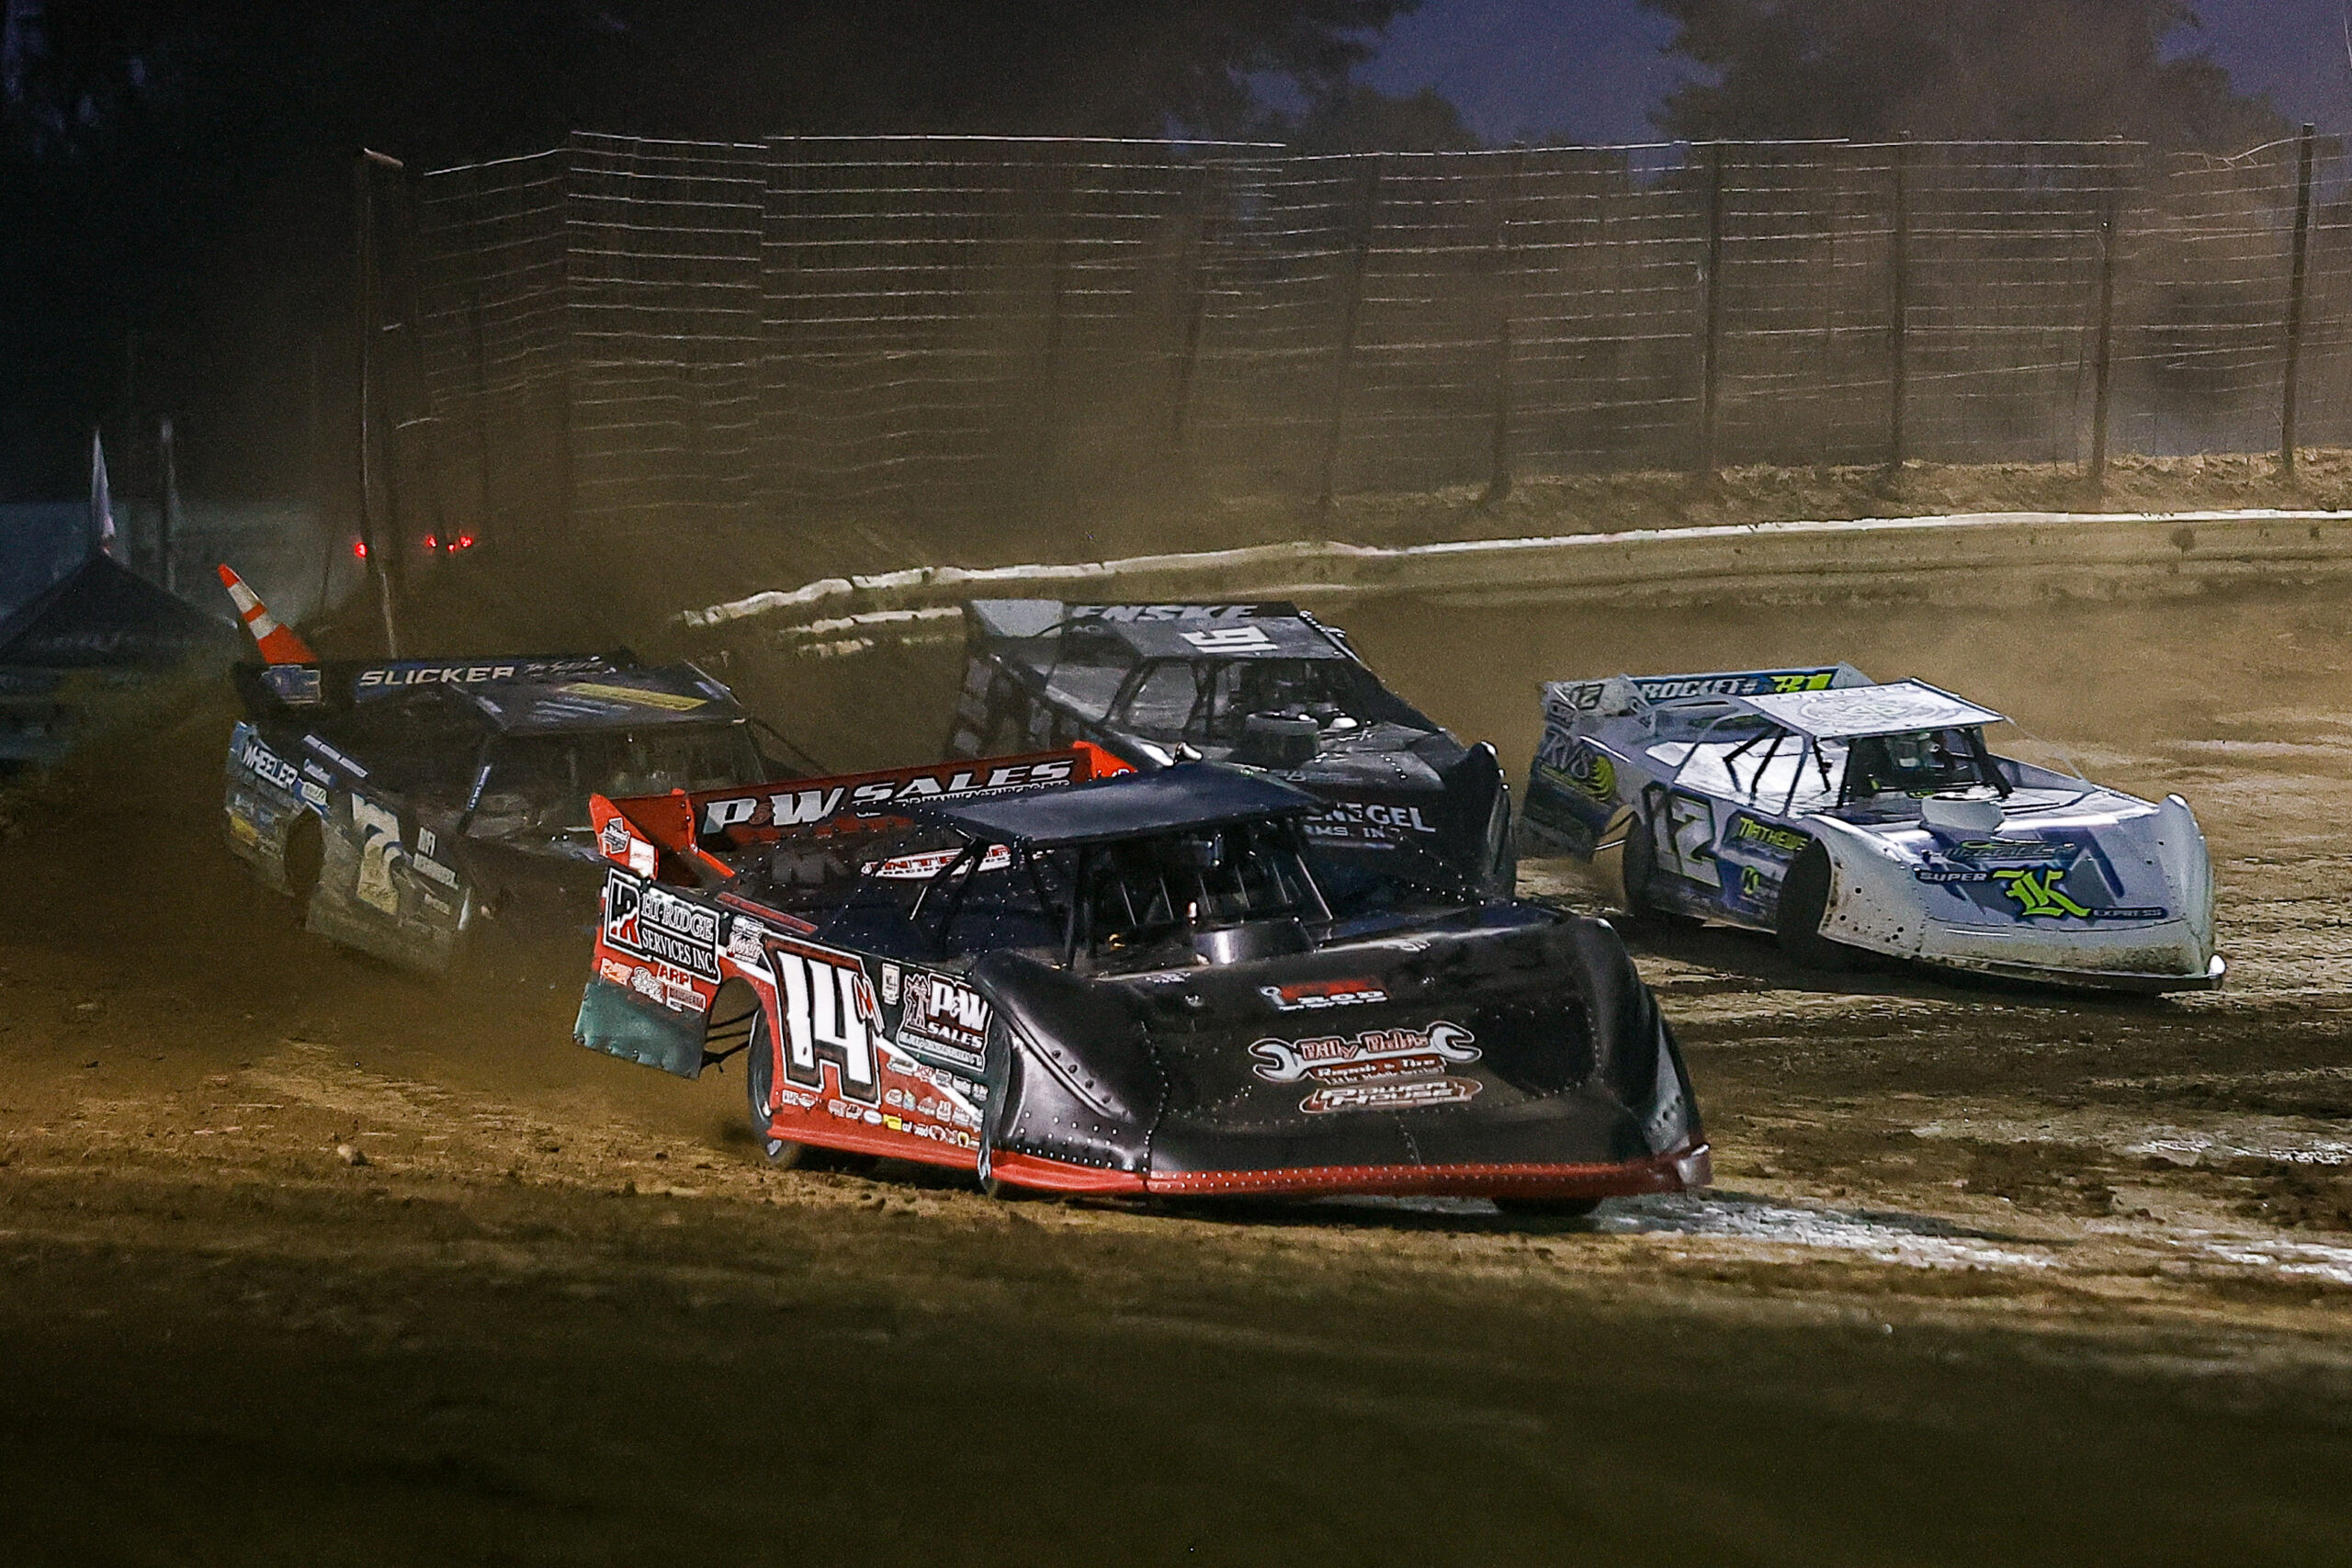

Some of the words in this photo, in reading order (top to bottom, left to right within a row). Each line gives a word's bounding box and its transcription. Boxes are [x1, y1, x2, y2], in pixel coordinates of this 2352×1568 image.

[359, 665, 515, 687] SLICKER
[242, 742, 300, 790] WHEELER
[702, 787, 844, 834] P&W
[852, 760, 1074, 805] SALES
[1919, 872, 1988, 883] SUPER
[641, 927, 692, 965] SERVICES
[692, 946, 718, 976] INC.
[659, 964, 690, 986] ARP
[775, 950, 873, 1086] 14
[929, 979, 989, 1032] P&W
[927, 1021, 984, 1049] SALES
